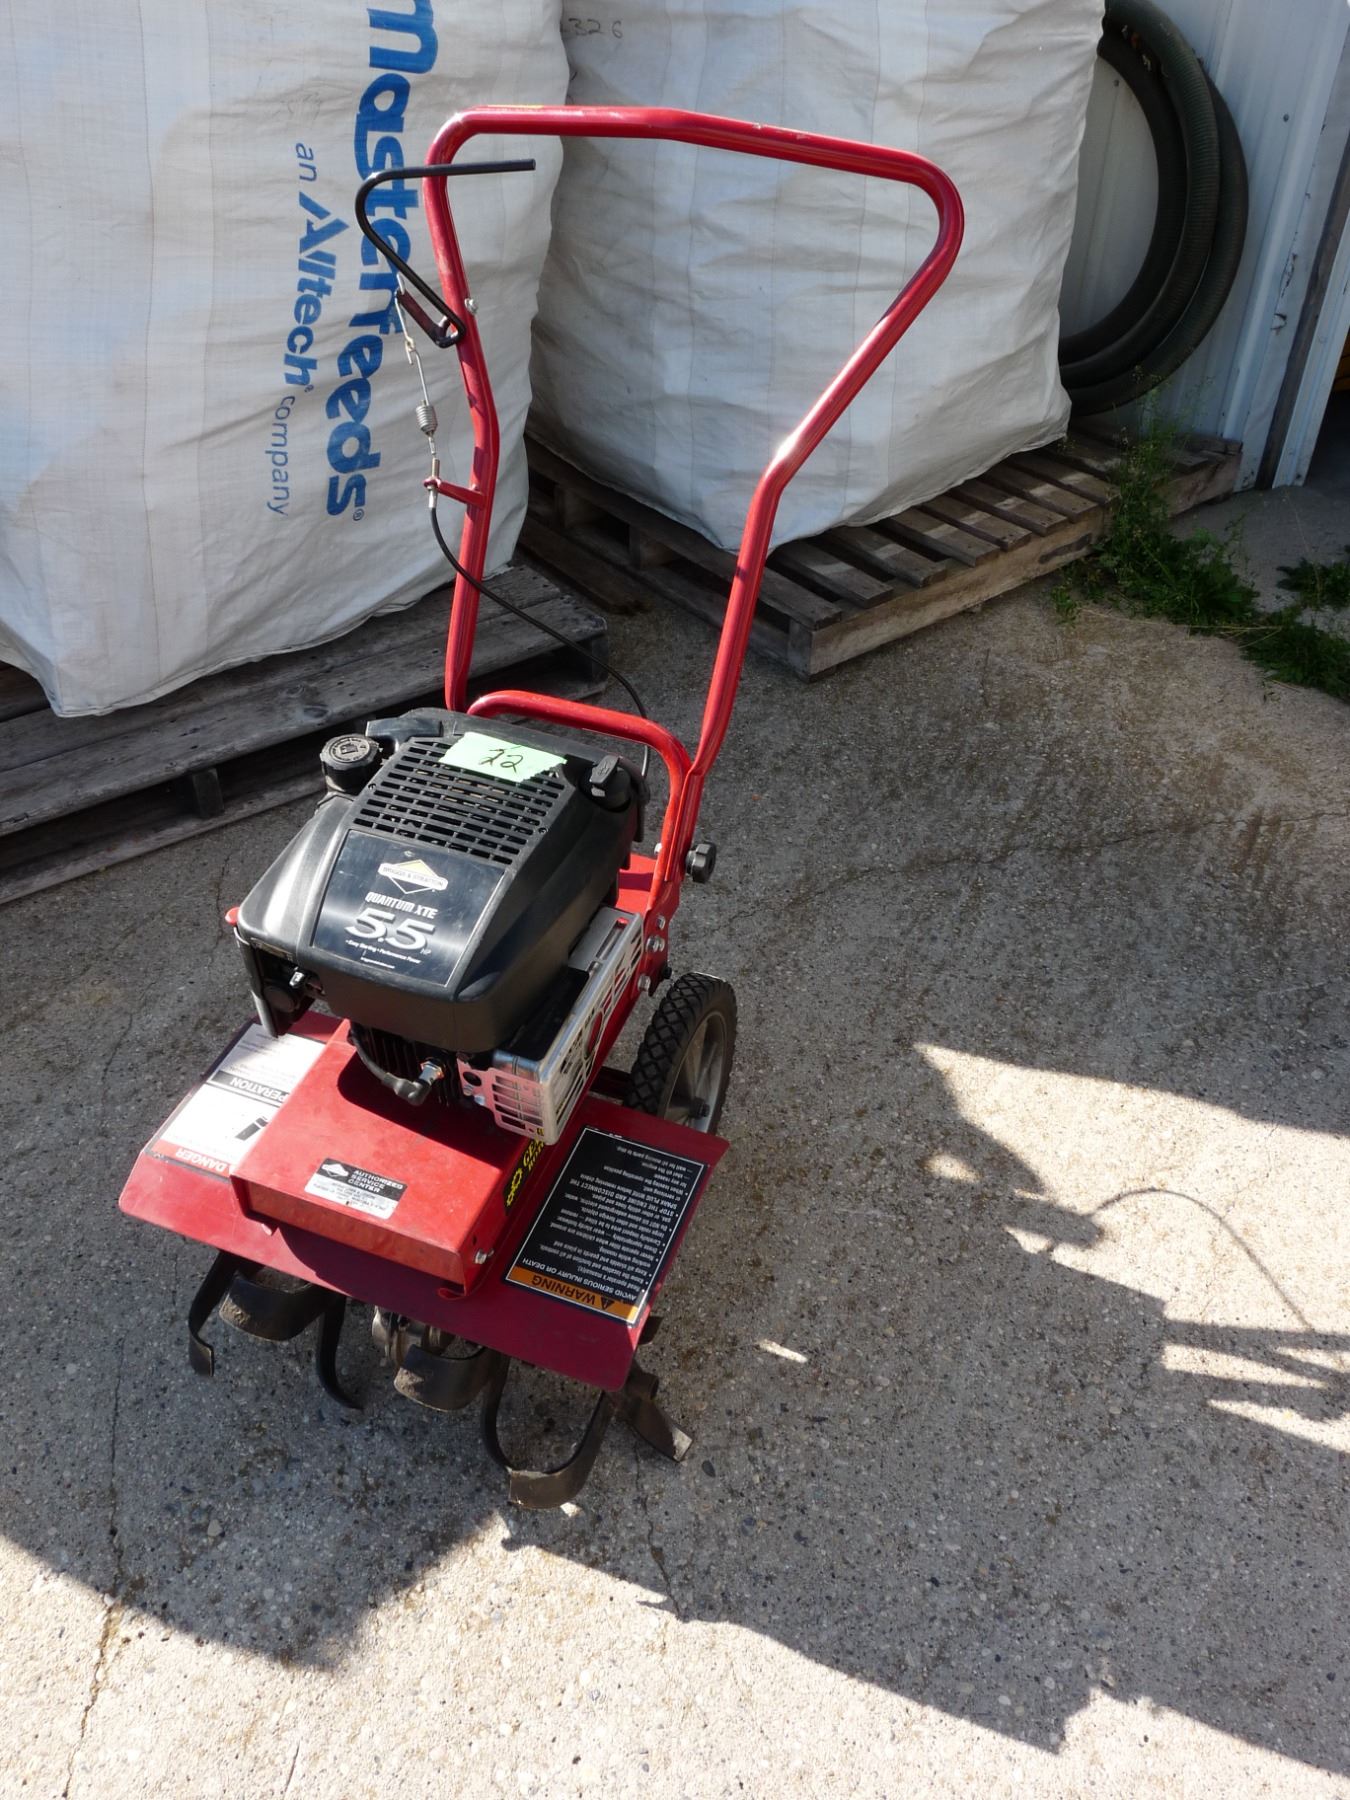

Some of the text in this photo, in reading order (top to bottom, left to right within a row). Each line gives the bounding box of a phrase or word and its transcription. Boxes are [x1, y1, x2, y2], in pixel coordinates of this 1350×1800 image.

[265, 142, 350, 517] an Alltech company
[364, 892, 439, 919] QUANTUM XTE
[344, 907, 437, 950] 5.5
[230, 1077, 289, 1103] PERATION
[175, 1147, 229, 1173] DANGER
[347, 1179, 381, 1193] CENTER
[350, 1174, 385, 1190] SERVICE
[353, 1170, 404, 1190] AUTHORIZED
[580, 1182, 614, 1196] DISCONNECT
[614, 1193, 627, 1201] AND
[659, 1207, 674, 1216] STOP
[522, 1257, 545, 1269] DEATH
[557, 1269, 583, 1282] INJURY
[531, 1274, 597, 1306] WARNING
[582, 1278, 613, 1293] SERIOUS
[613, 1288, 636, 1300] AVOID
